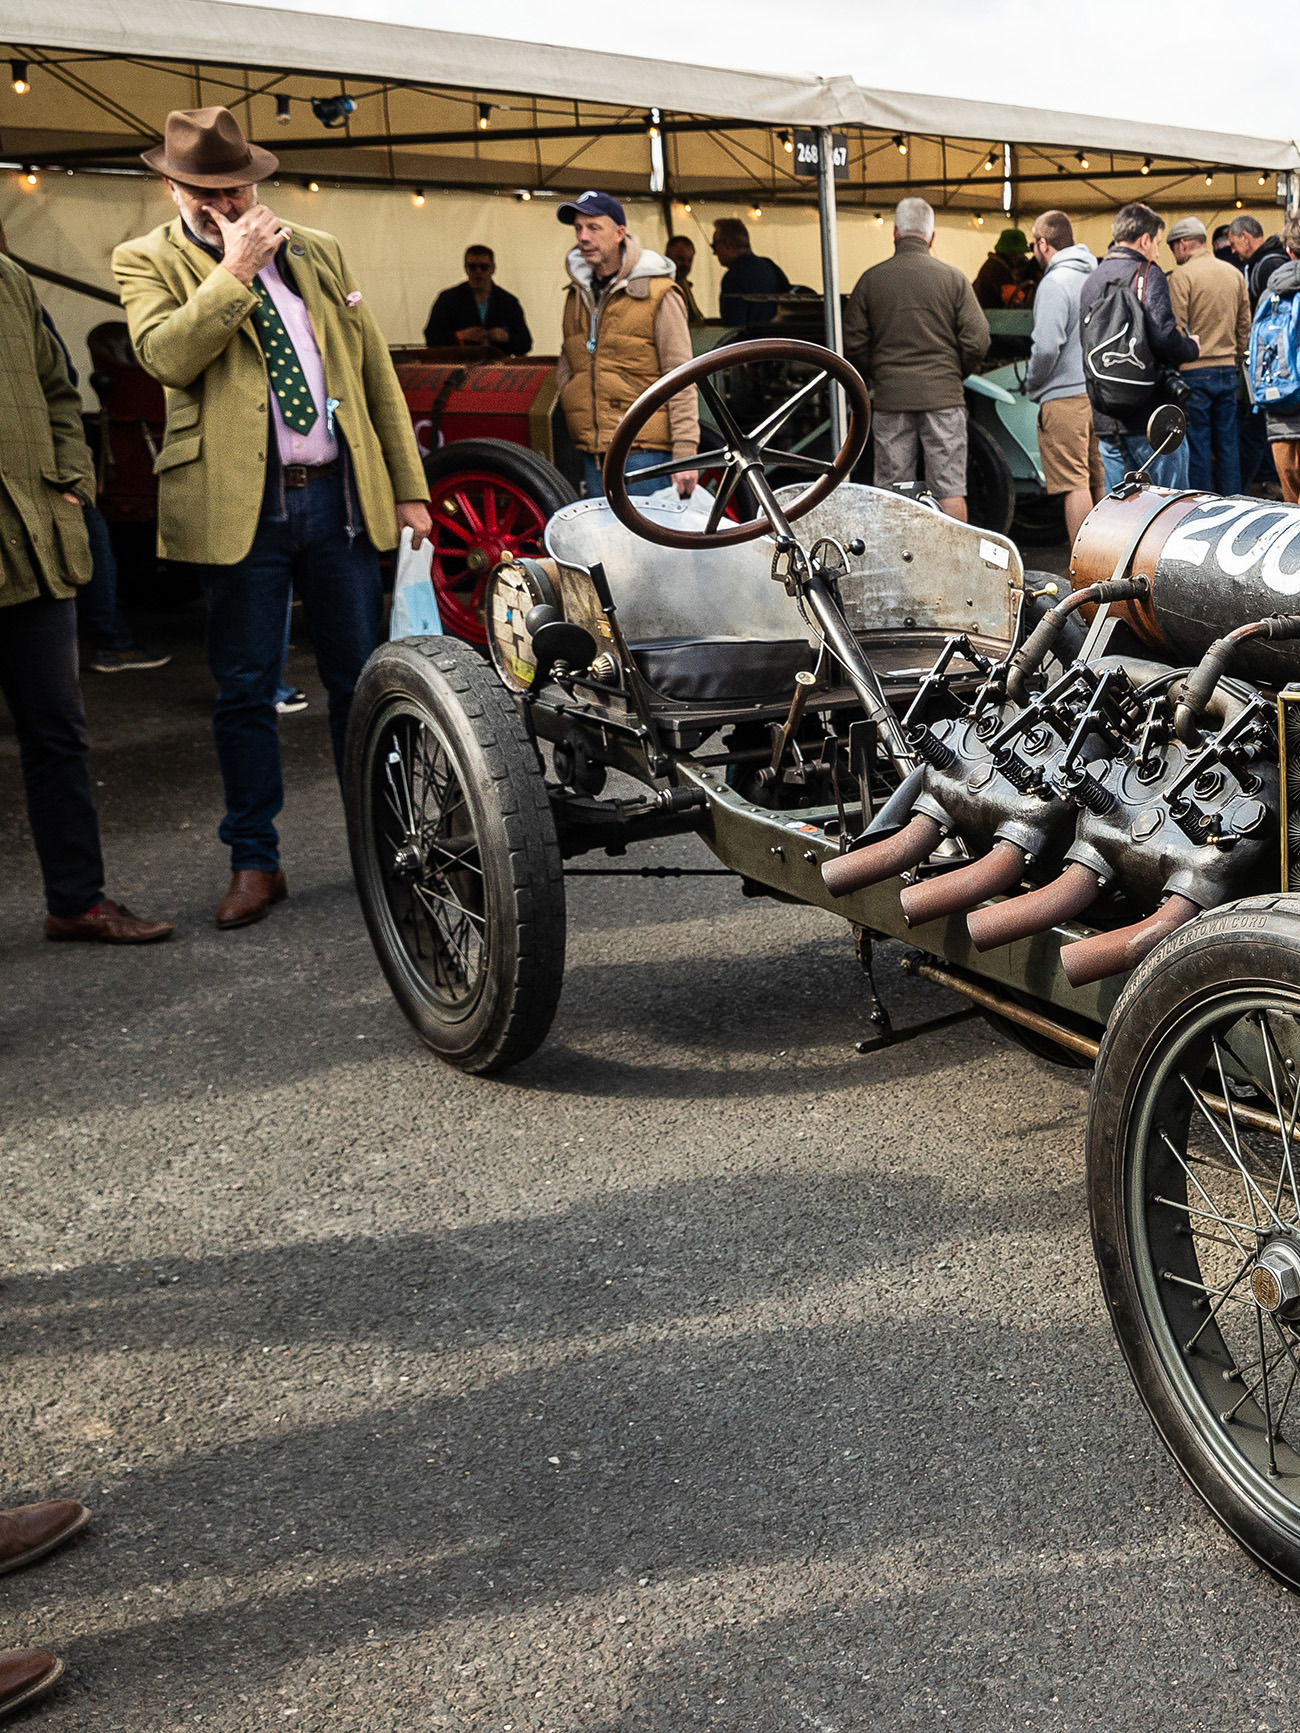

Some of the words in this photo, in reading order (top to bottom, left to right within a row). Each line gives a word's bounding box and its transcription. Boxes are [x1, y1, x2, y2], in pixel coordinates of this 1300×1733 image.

[797, 142, 819, 164] 268
[833, 146, 847, 167] 67
[1230, 914, 1268, 930] CORD
